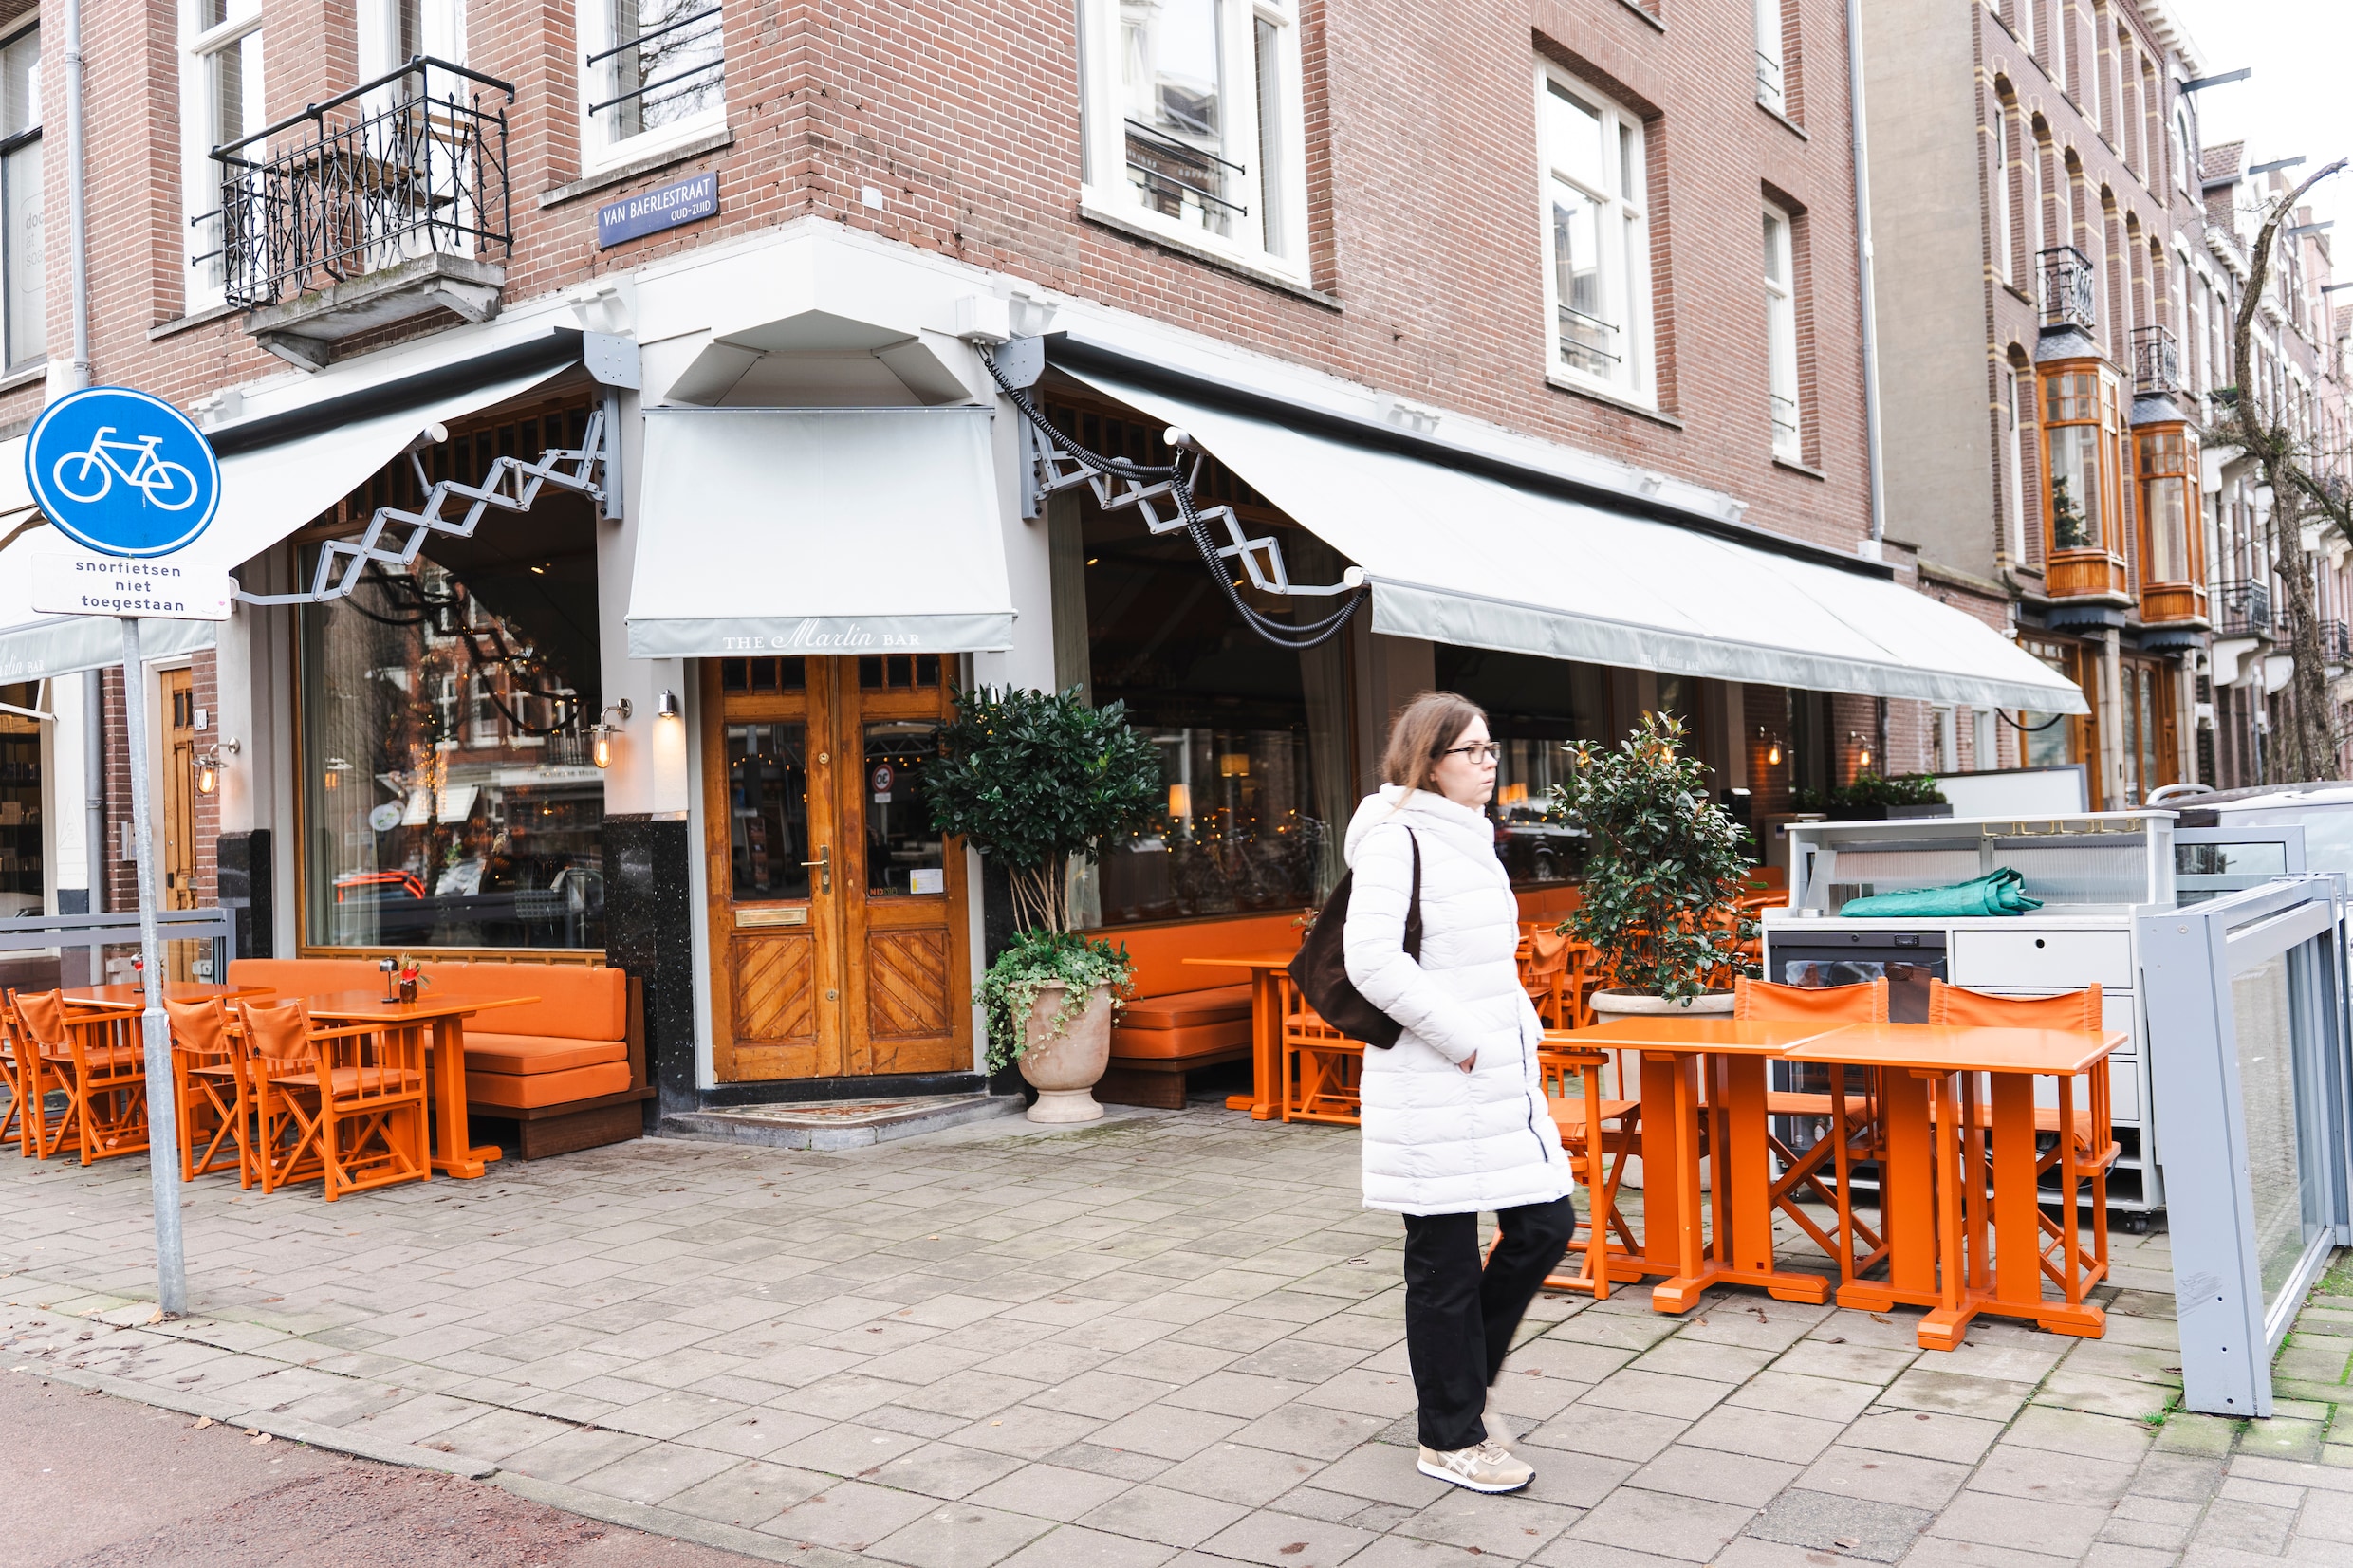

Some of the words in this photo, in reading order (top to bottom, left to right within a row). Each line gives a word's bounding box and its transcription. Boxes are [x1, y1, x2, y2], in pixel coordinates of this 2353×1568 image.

[603, 205, 626, 227] VAN
[630, 178, 711, 219] BAERLESTRAAT
[670, 200, 711, 221] OUD-ZUID
[26, 249, 45, 267] soa
[76, 562, 181, 577] snorfietsen
[115, 580, 151, 592] niet
[82, 595, 184, 612] toegestaan
[722, 636, 765, 650] THE
[770, 617, 877, 648] Marlin
[882, 634, 920, 646] BAR
[28, 659, 45, 673] BAR
